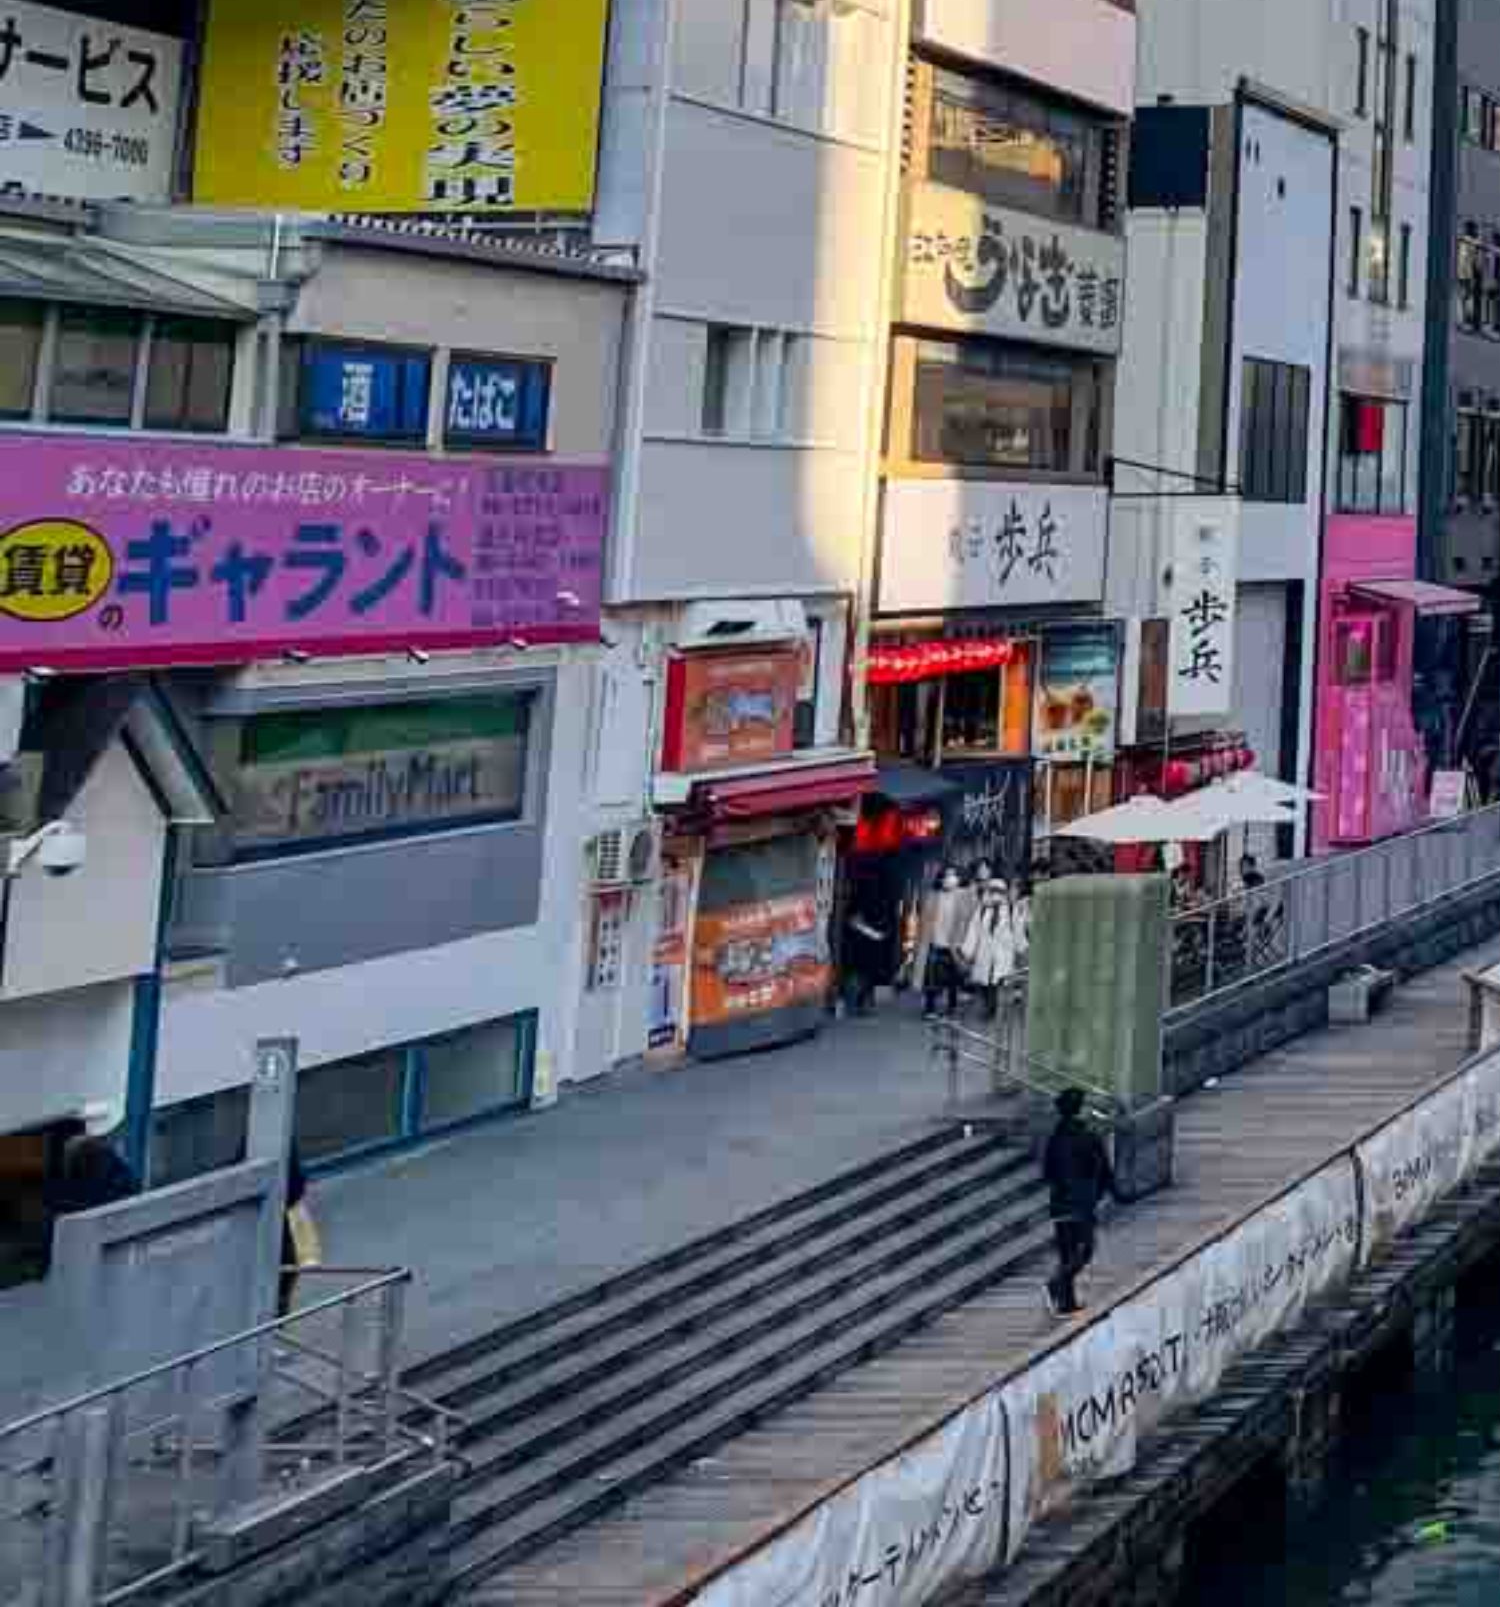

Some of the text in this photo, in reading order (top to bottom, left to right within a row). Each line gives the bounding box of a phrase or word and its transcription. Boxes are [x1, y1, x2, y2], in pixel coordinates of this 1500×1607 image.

[448, 370, 517, 431] たばこ
[3, 542, 96, 597] 賃貸
[119, 514, 469, 625] ギャラント
[995, 496, 1058, 587] 歩兵
[100, 603, 124, 634] の
[1178, 589, 1228, 684] 歩兵
